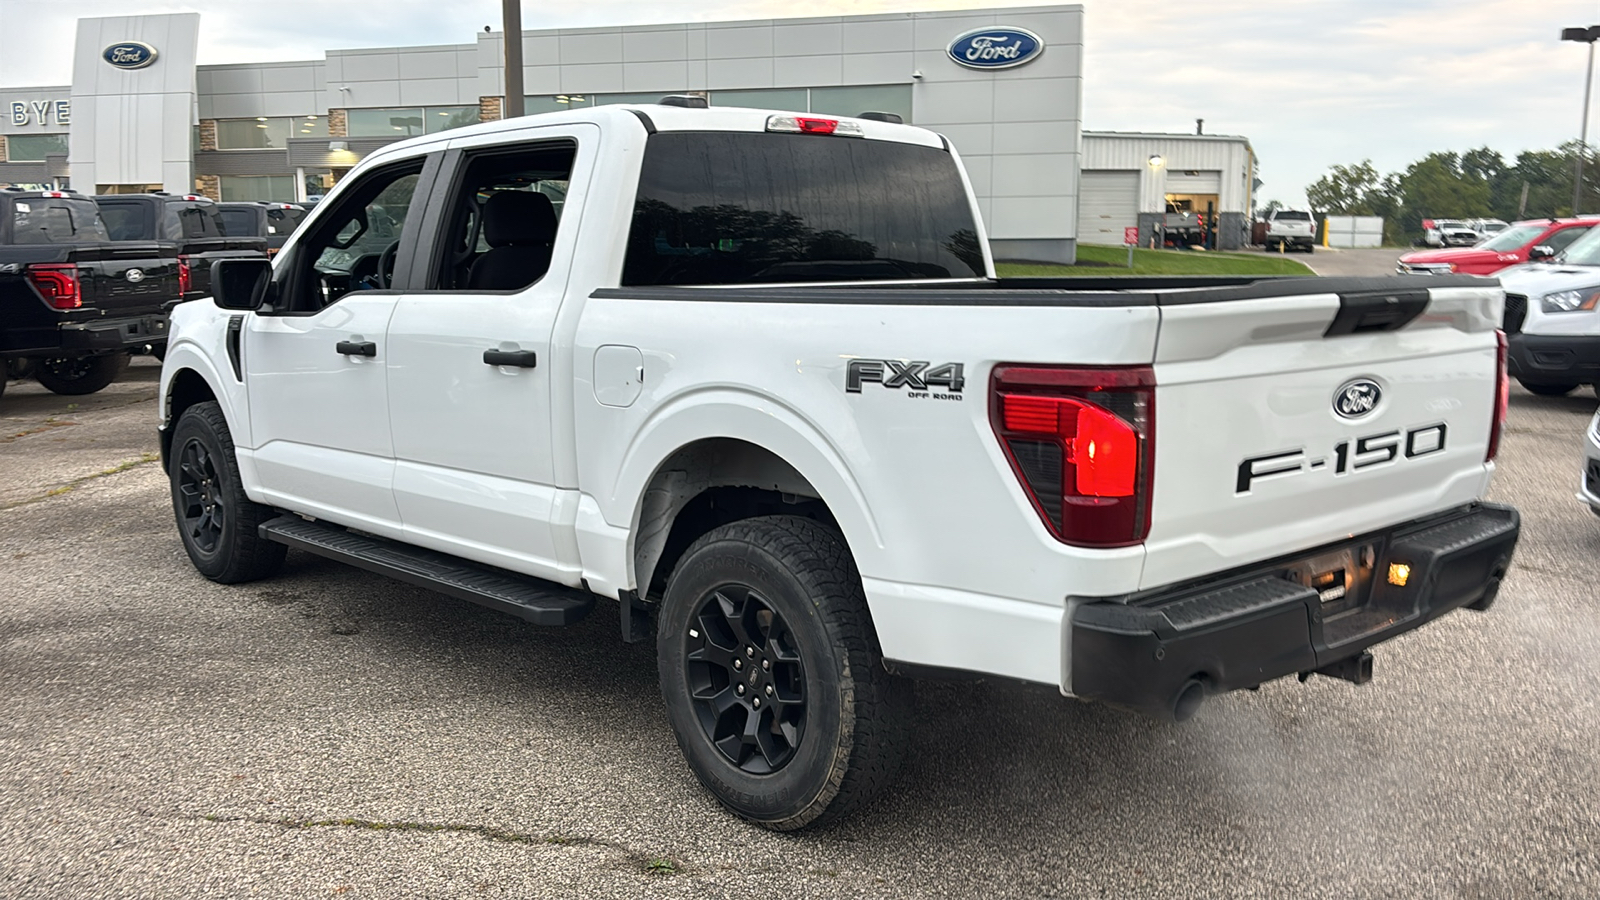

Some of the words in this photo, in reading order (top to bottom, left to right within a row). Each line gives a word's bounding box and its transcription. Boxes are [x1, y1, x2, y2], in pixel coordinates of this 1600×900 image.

[111, 47, 141, 62] Ford
[966, 35, 1021, 60] Ford
[846, 358, 965, 394] FX4
[908, 391, 930, 399] OFF
[933, 392, 963, 401] ROAD
[1342, 384, 1377, 413] Ford
[1235, 421, 1446, 494] F-150
